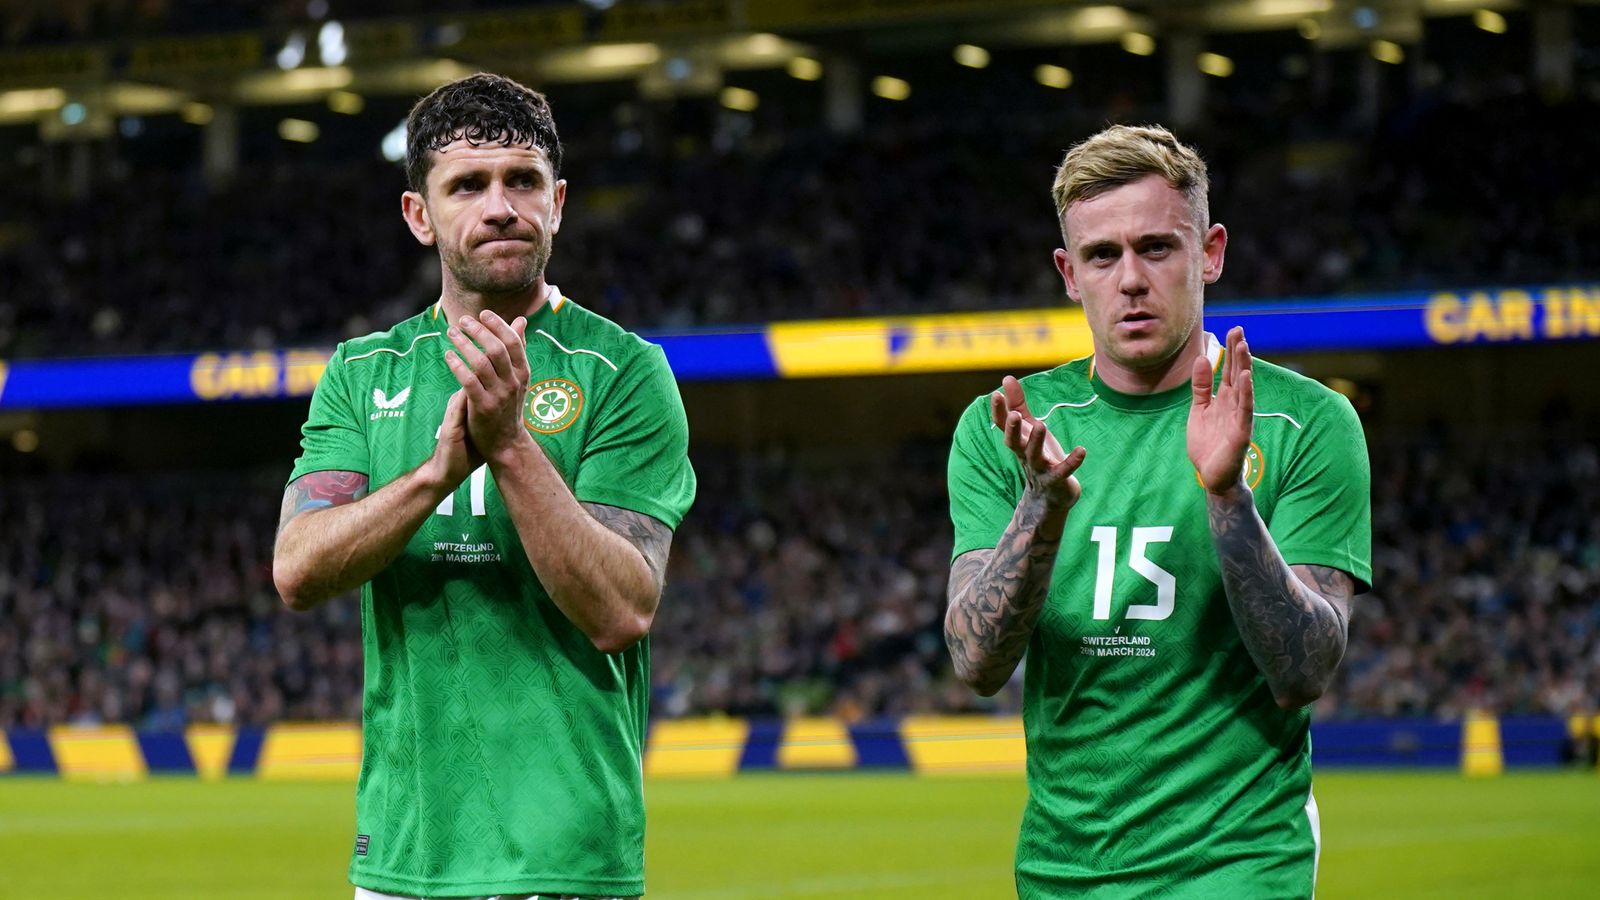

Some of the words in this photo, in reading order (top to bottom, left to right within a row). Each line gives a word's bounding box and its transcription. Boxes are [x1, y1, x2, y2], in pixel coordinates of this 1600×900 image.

[1424, 290, 1531, 344] CAR
[530, 381, 578, 399] IRELAND
[445, 554, 480, 563] MARCH
[1090, 526, 1176, 621] 15
[1082, 636, 1151, 646] SWITZERLAND
[1097, 647, 1134, 657] MARCH
[1135, 648, 1156, 657] 2024
